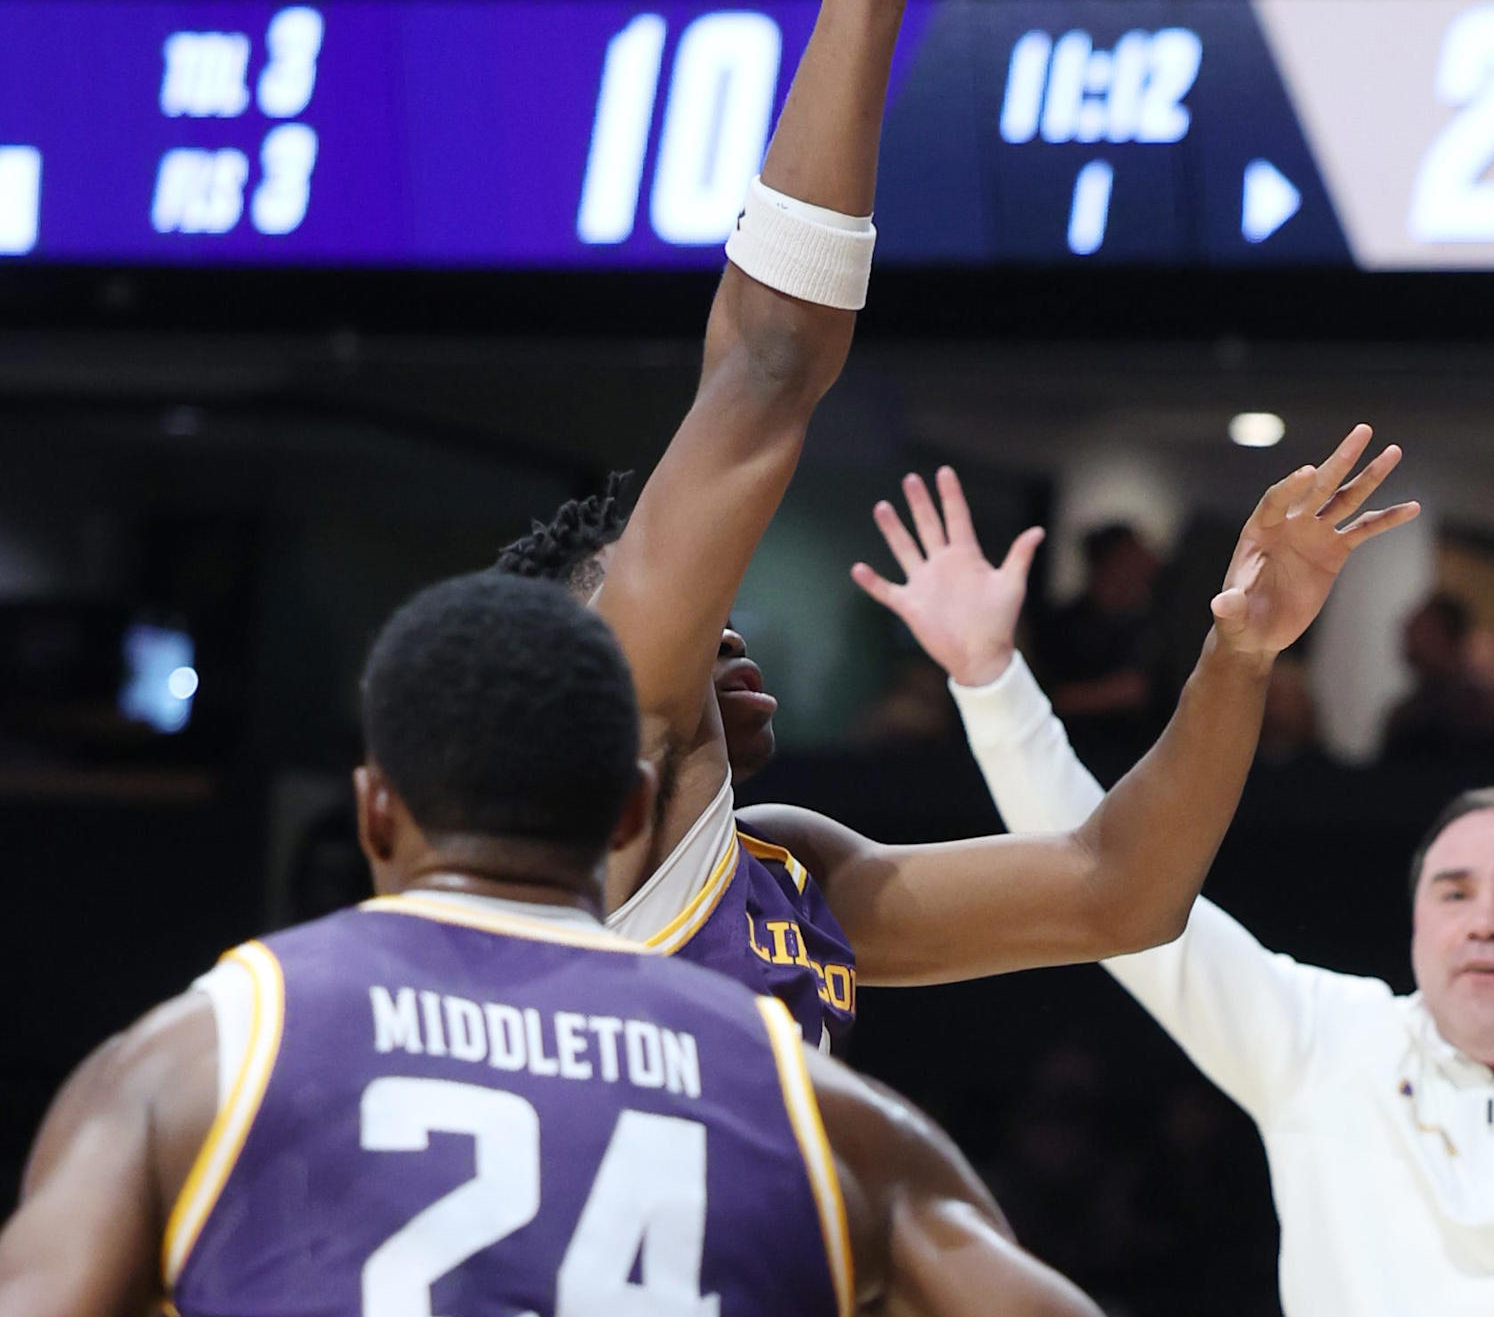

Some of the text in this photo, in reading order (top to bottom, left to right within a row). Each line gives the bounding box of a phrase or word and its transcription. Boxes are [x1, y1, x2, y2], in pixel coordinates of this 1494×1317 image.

[576, 10, 782, 245] 10
[1066, 159, 1114, 255] 1
[369, 985, 701, 1099] MIDDLETON
